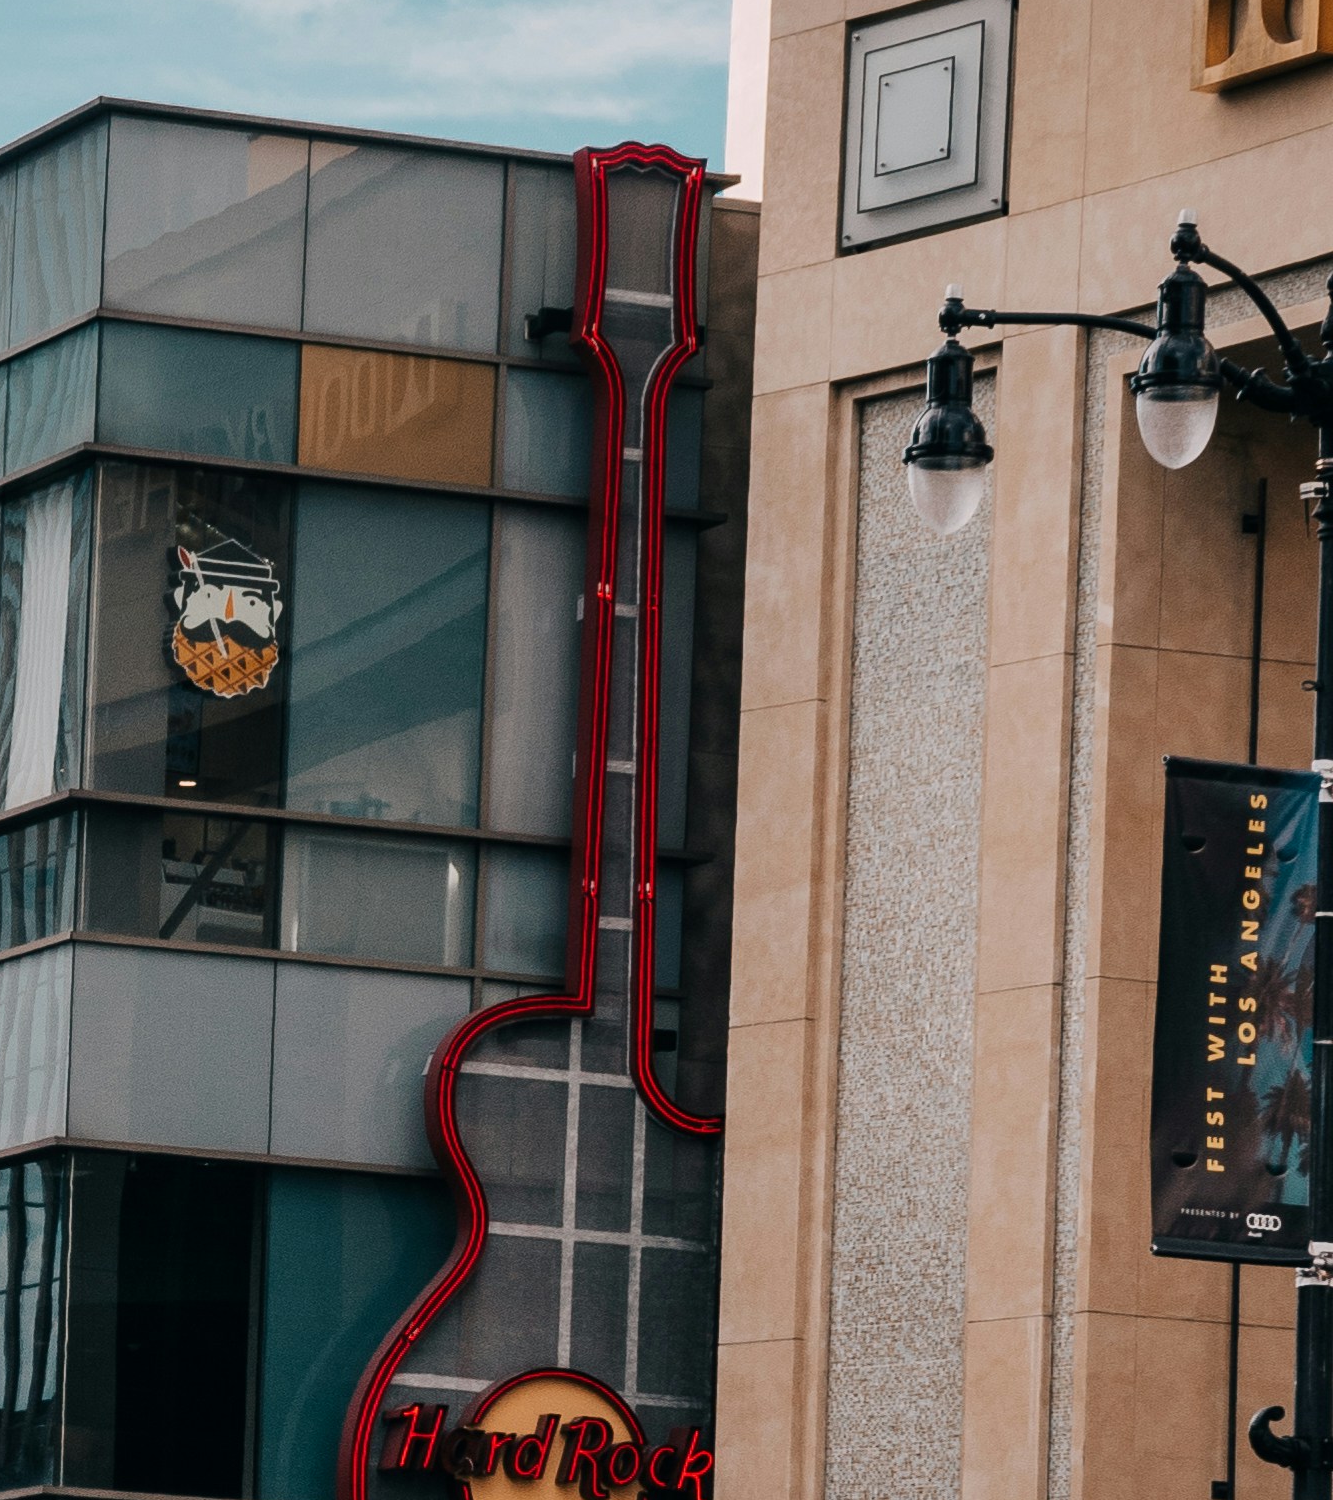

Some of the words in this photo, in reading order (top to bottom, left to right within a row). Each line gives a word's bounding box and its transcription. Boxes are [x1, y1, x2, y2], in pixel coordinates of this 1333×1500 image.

[1240, 793, 1269, 972] ANGELES
[1207, 963, 1229, 1062] WITH
[1237, 996, 1257, 1067] LOS
[1206, 1087, 1226, 1174] FEST
[1180, 1207, 1226, 1219] PRESENTED
[1229, 1211, 1240, 1219] BY
[378, 1402, 560, 1481] Hard
